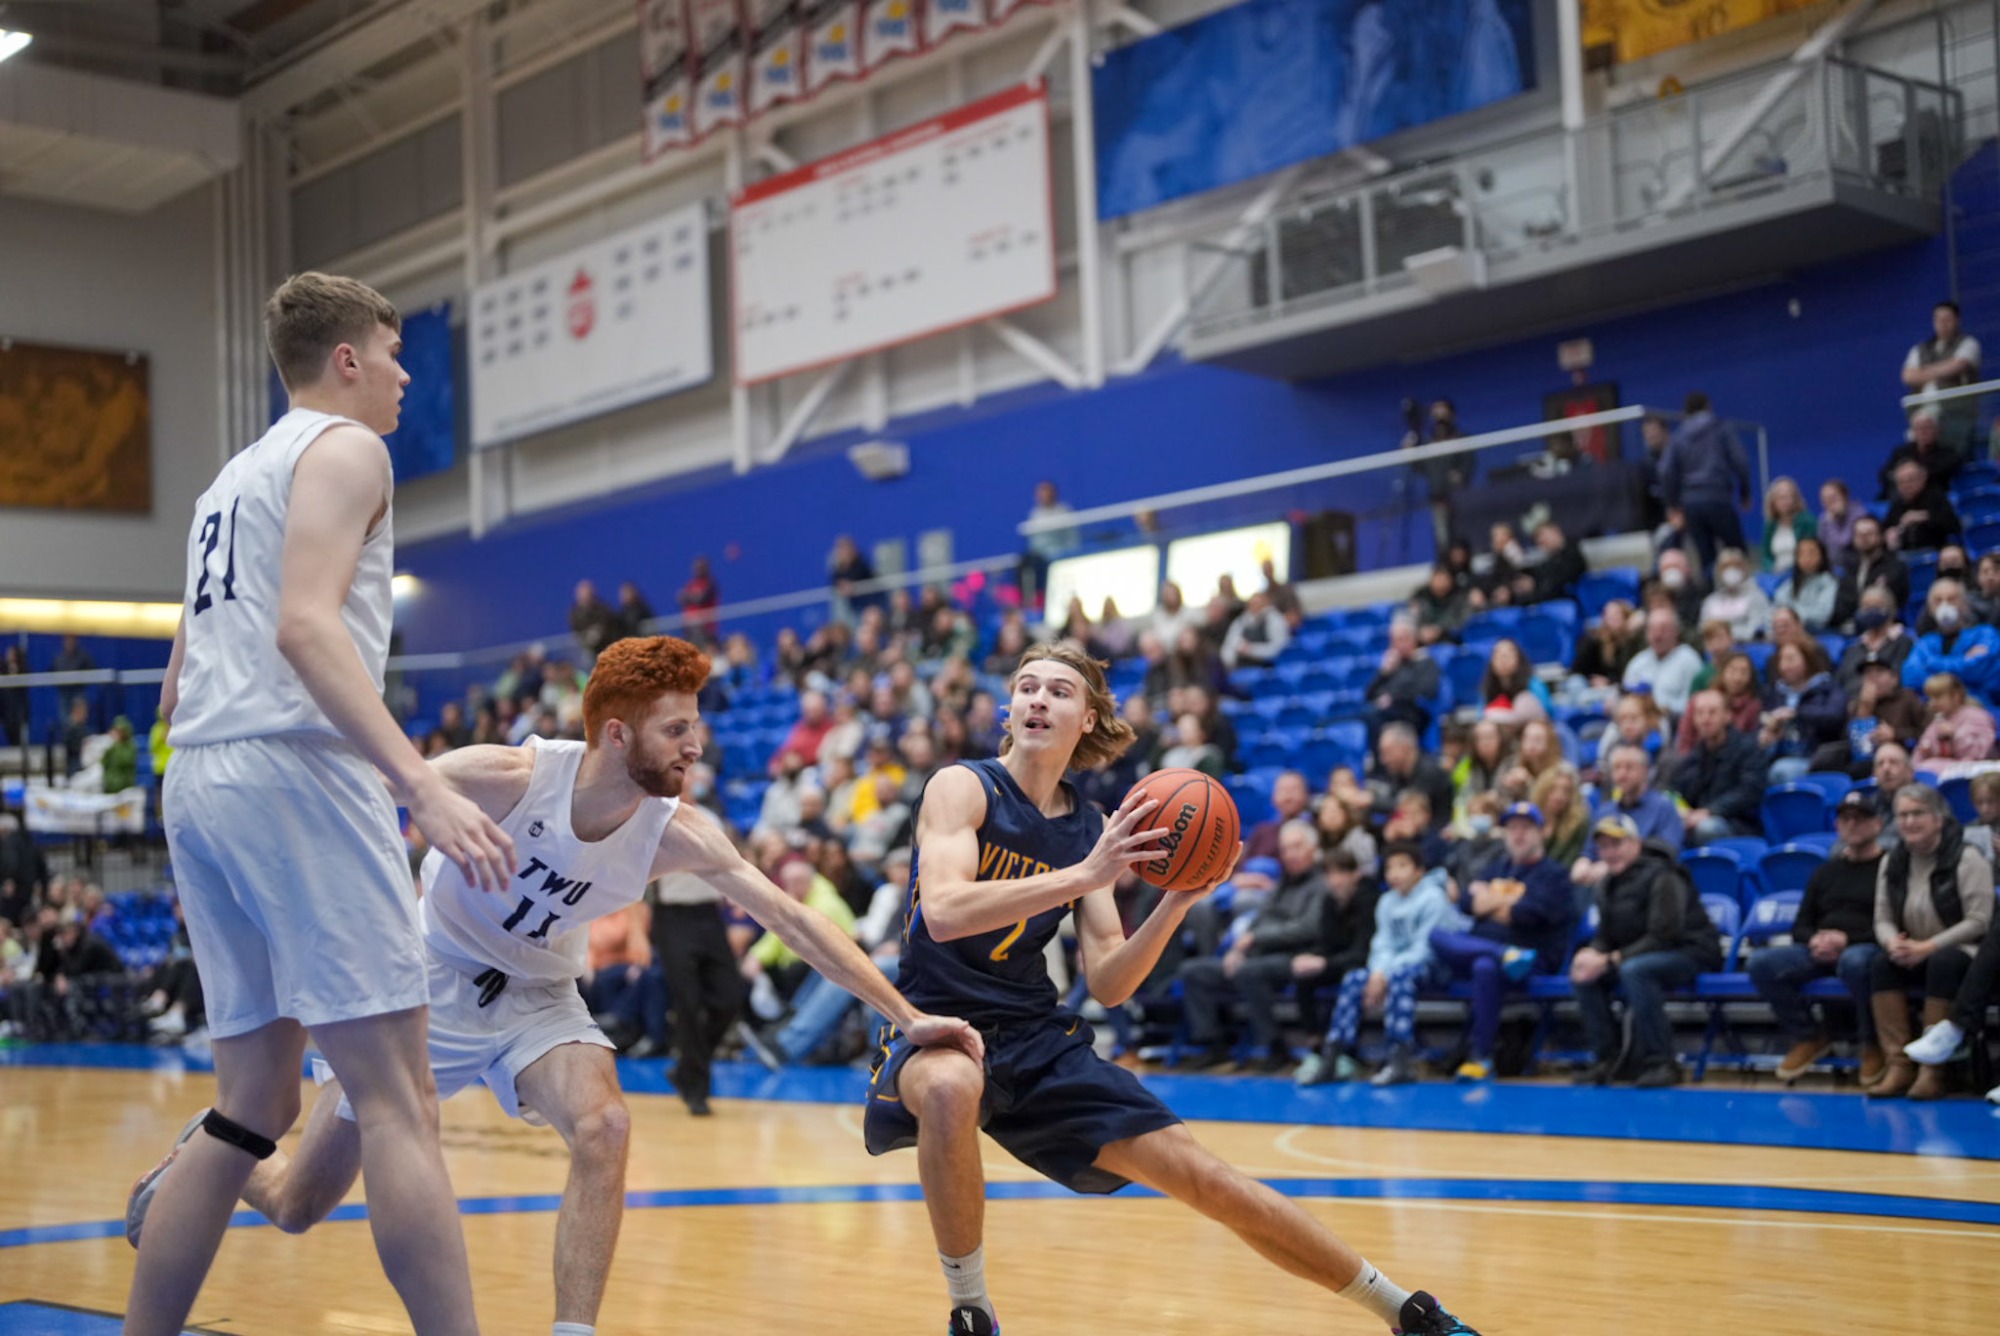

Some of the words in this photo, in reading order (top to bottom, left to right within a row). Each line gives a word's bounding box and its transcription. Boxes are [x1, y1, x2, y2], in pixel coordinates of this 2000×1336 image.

[194, 494, 240, 616] 21
[518, 856, 593, 906] TWU
[502, 895, 561, 939] 11
